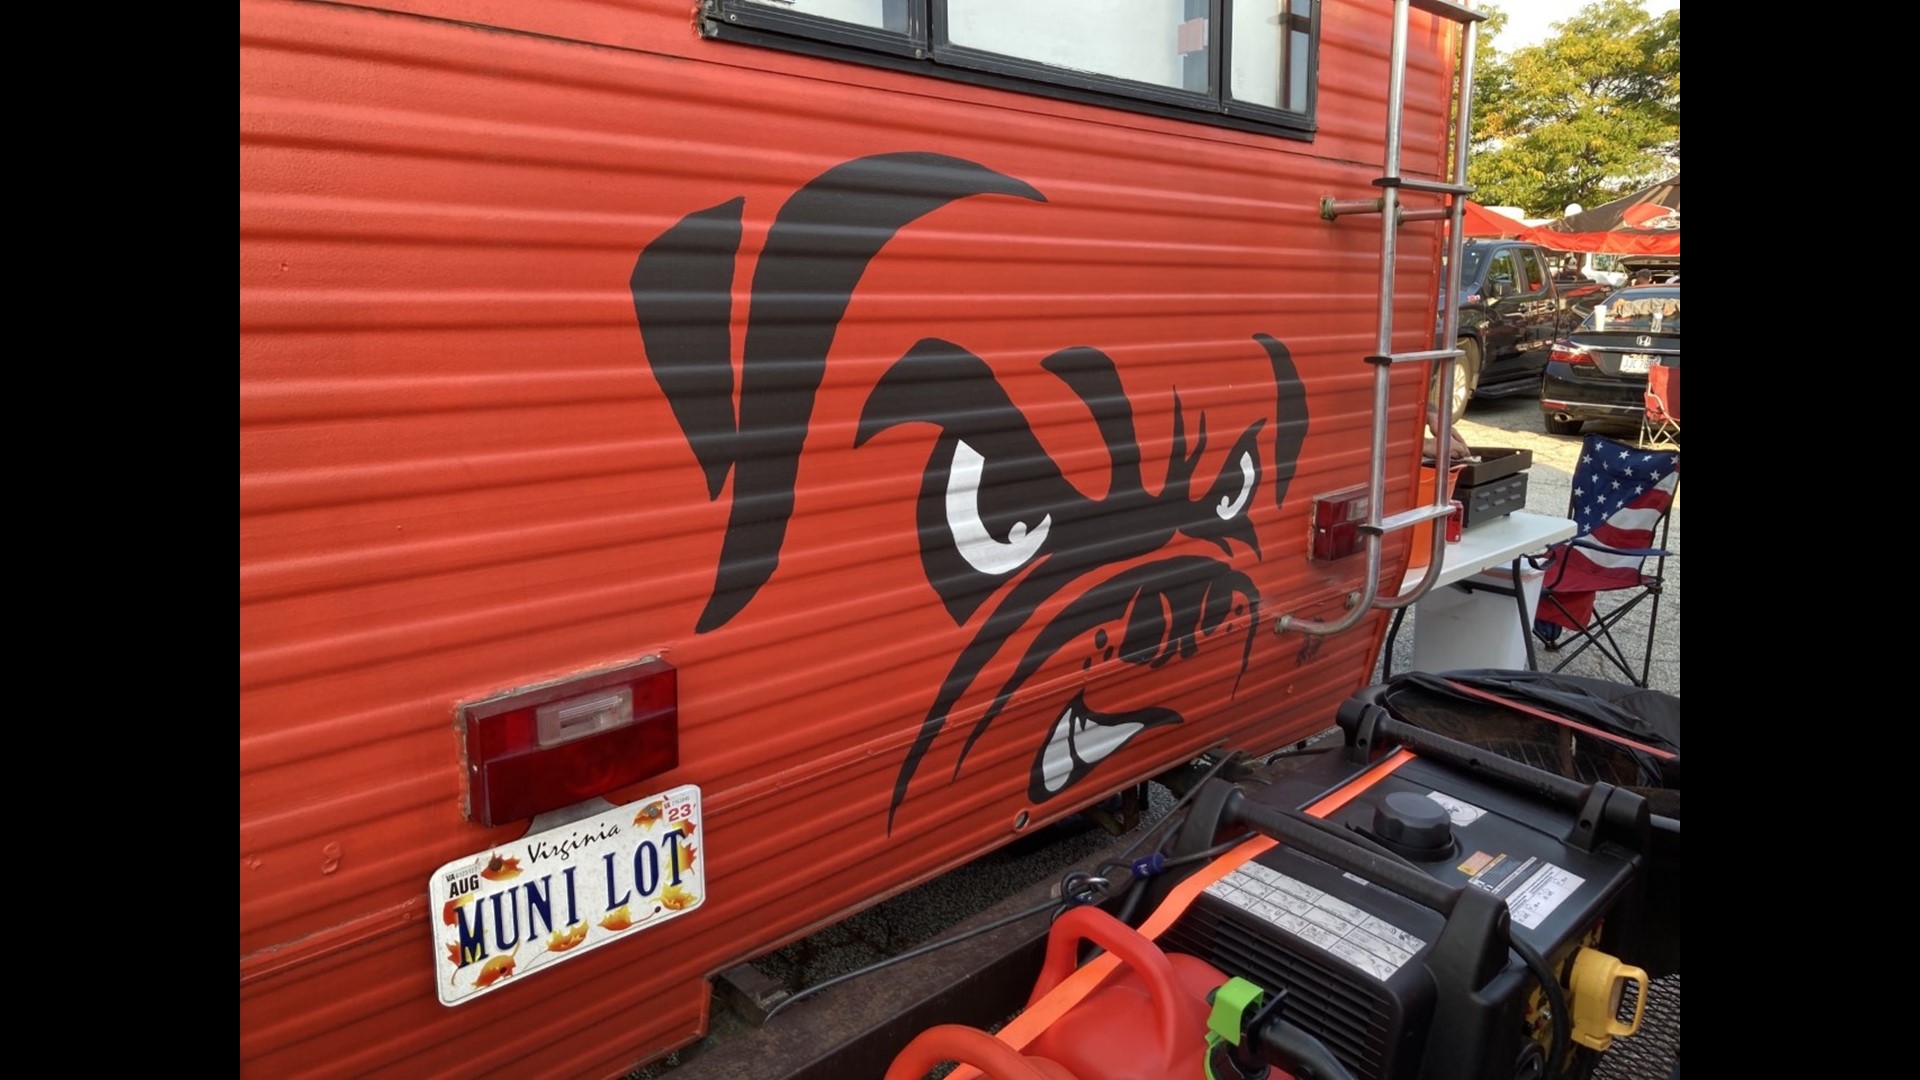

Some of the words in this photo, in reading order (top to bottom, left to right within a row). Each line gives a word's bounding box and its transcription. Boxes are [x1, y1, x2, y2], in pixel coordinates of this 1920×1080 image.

[668, 803, 692, 822] 23
[527, 823, 621, 863] Virginia
[446, 873, 456, 882] VA
[450, 874, 479, 899] AUG
[453, 866, 580, 969] MUNI
[602, 828, 687, 912] LOT
